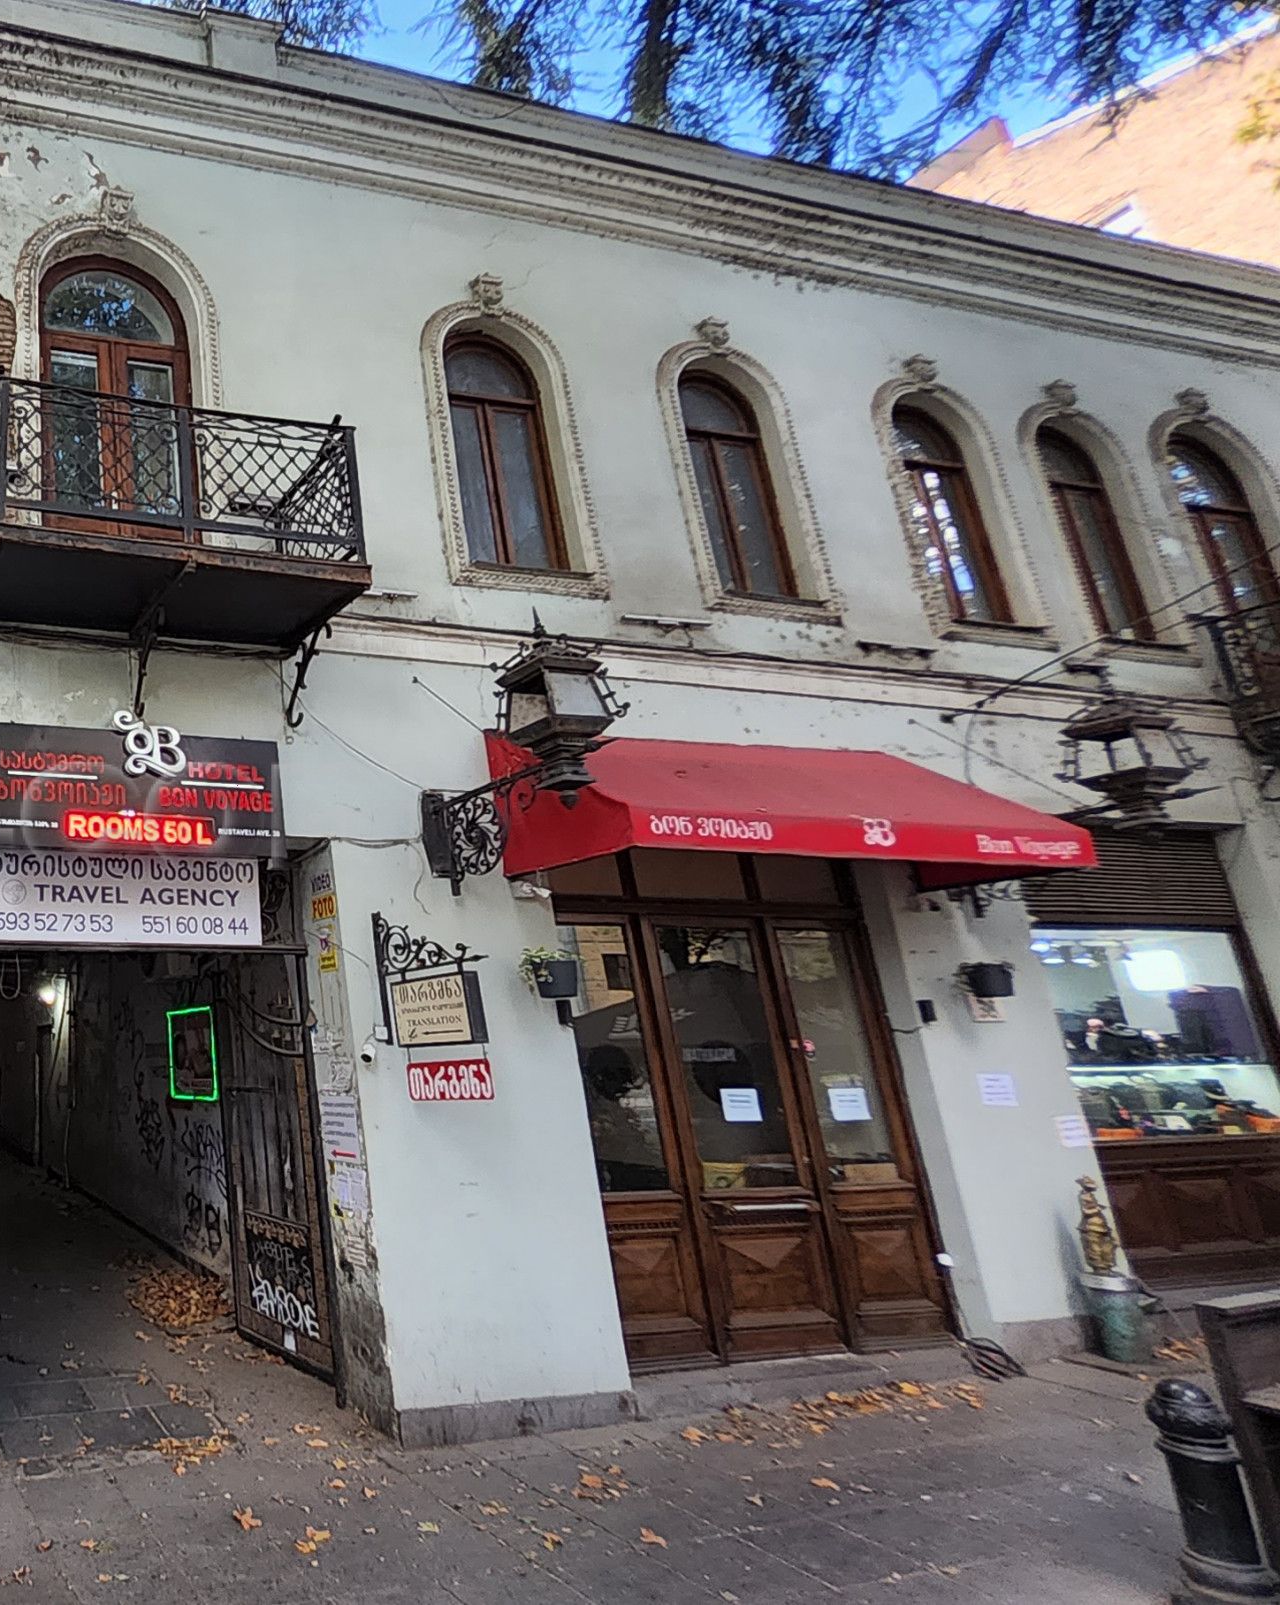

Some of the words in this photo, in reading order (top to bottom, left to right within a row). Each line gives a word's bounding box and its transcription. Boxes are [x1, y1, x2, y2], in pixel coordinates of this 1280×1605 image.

[187, 760, 266, 784] HOTEL
[159, 786, 199, 809] BON
[203, 788, 274, 813] VOYAGE
[67, 814, 161, 843] ROOMS
[196, 821, 213, 845] L
[217, 826, 256, 837] RUSTAVELI
[649, 814, 694, 836] ბონ
[975, 834, 1017, 855] Bon
[149, 858, 255, 884] საგენტო
[33, 883, 129, 905] TRAVEL
[139, 887, 240, 907] AGENCY
[312, 895, 335, 919] FOTO
[34, 913, 58, 932] 52
[62, 914, 86, 933] 73
[90, 914, 114, 933] 53
[141, 915, 171, 935] 551
[176, 916, 198, 935] 60
[201, 917, 224, 936] 08
[228, 917, 249, 936] 44
[399, 978, 462, 1004] თარგმნა
[409, 1063, 493, 1100] თარგმნა
